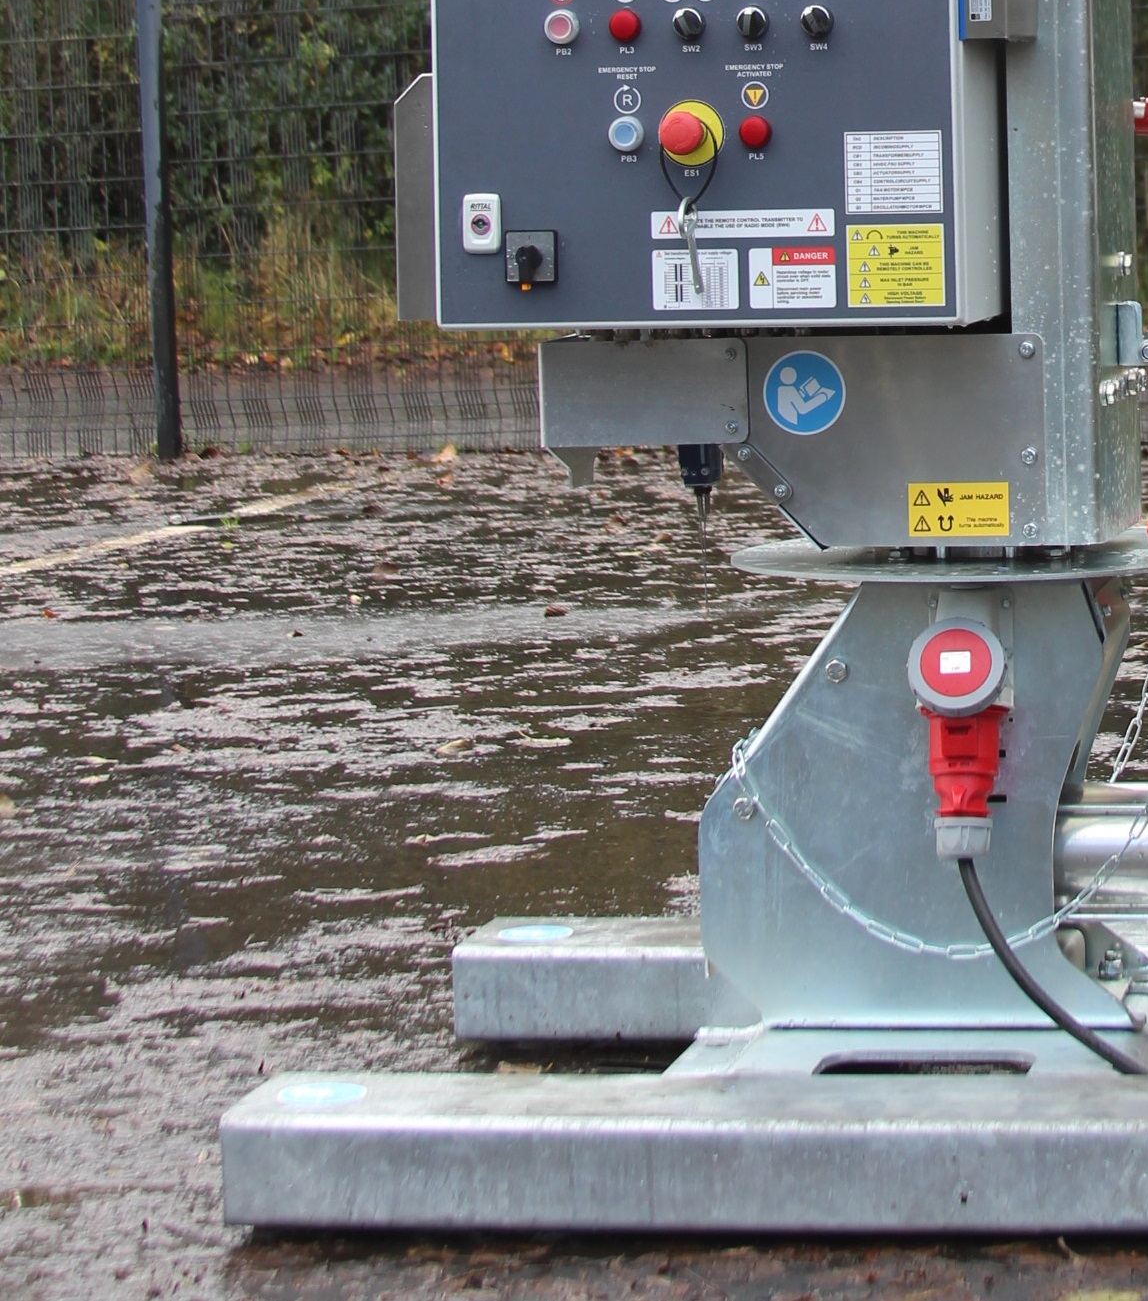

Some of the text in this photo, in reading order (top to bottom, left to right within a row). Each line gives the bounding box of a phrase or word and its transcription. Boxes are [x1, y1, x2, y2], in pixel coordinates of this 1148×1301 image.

[619, 46, 635, 54] PL3
[682, 45, 701, 53] SW2
[744, 43, 763, 51] SW3
[810, 43, 828, 51] SW4
[555, 48, 572, 56] PB2
[598, 66, 638, 74] EMERGENCY
[736, 70, 772, 78] ACTIVATED
[622, 94, 633, 106] R
[621, 155, 638, 163] PB3
[684, 169, 700, 177] ES1
[793, 252, 829, 260] DANGER
